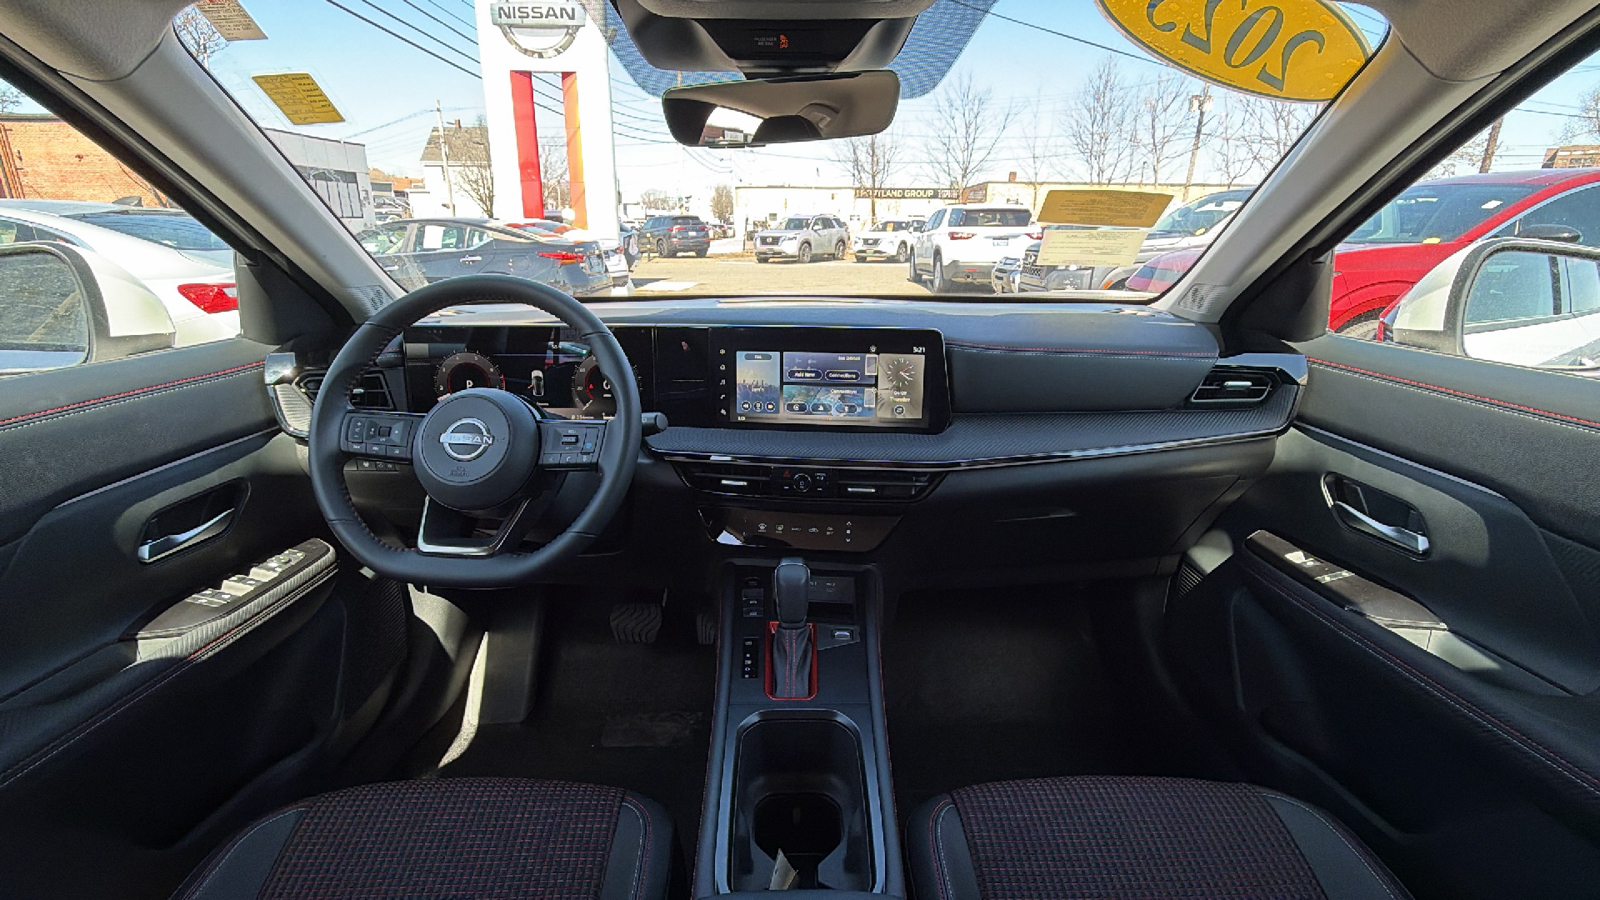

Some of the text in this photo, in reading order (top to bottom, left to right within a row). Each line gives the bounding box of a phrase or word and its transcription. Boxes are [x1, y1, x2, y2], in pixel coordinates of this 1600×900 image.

[498, 6, 576, 20] NISSAN
[904, 189, 934, 198] GROUP
[466, 379, 474, 389] P
[442, 434, 493, 445] ISSAN
